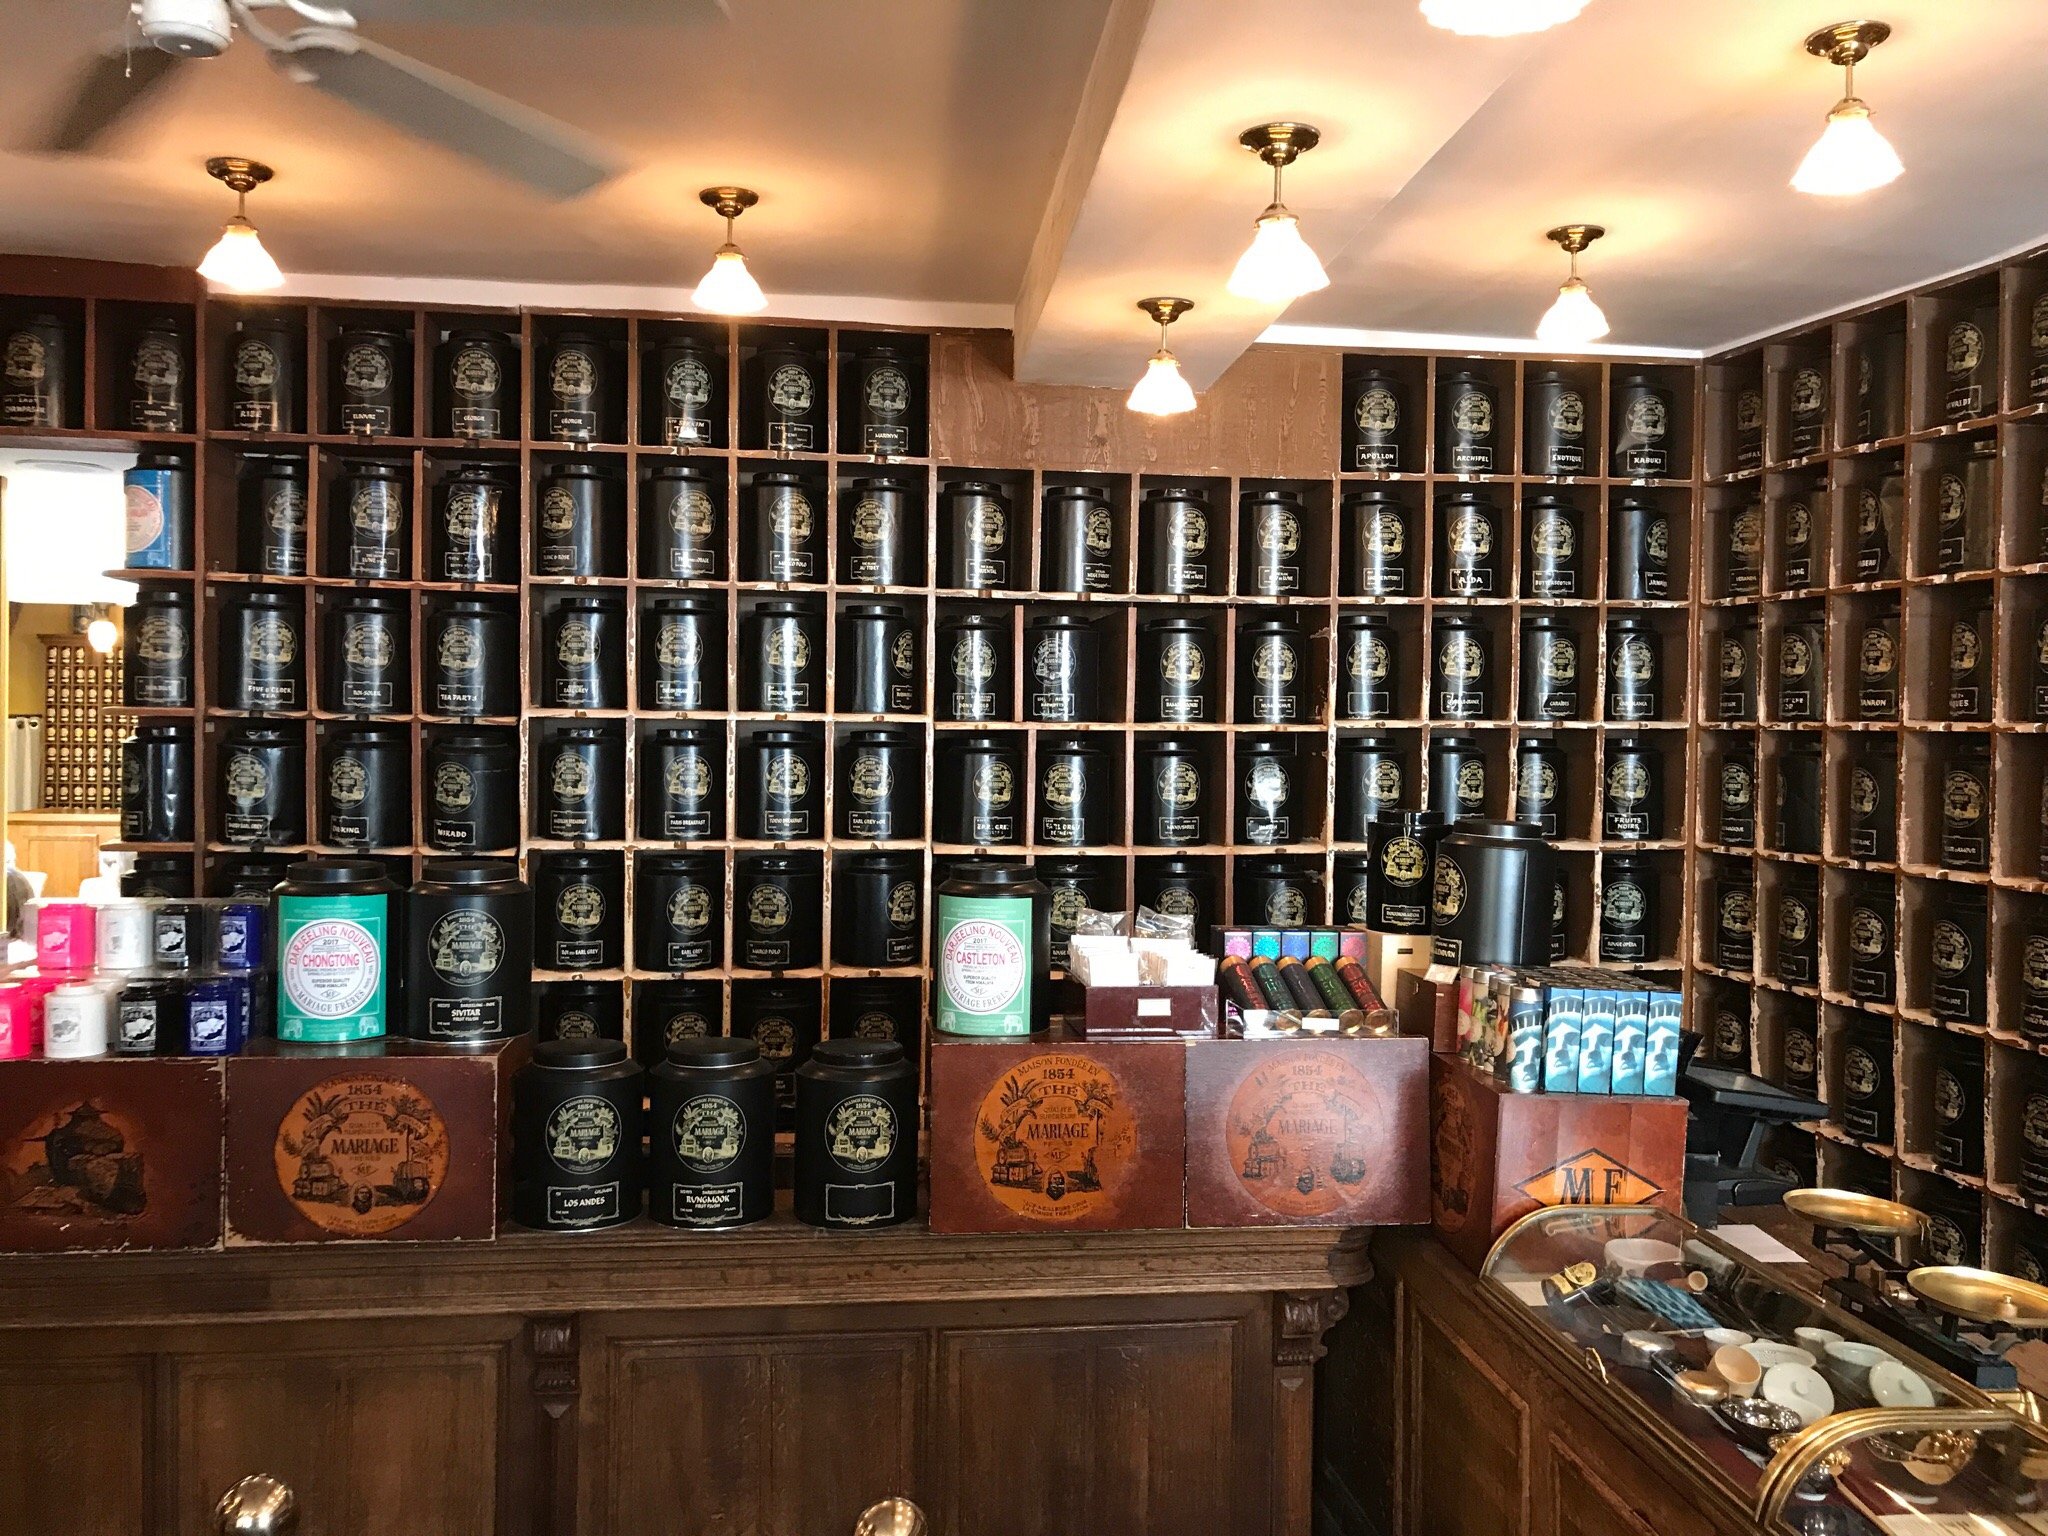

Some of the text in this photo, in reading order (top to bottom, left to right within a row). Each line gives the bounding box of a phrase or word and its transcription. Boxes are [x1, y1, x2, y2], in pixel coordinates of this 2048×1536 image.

[1360, 452, 1394, 460] APOLLON
[1456, 454, 1489, 463] ARCHIPEL
[1633, 456, 1662, 464] KABUKI
[1614, 816, 1642, 824] FRUITS
[288, 924, 376, 966] DARJEELING NOUVEAU
[322, 938, 339, 946] 2017
[451, 940, 485, 950] MARIAGE
[945, 925, 1019, 965] DARJEELING NOUVEAU
[302, 953, 360, 967] CHONGTONG
[956, 951, 1006, 965] CASTLETON
[296, 991, 333, 1014] MARIAGE
[951, 986, 981, 1009] MARIAGE
[451, 1008, 481, 1017] SIVITAR
[1017, 1058, 1053, 1077] MAISON
[1055, 1056, 1087, 1070] FONDÉE
[1292, 1065, 1323, 1076] 1854
[1043, 1068, 1076, 1080] 1854
[347, 1084, 383, 1096] 1854
[570, 1127, 601, 1138] MARIAGE
[694, 1127, 725, 1136] MARIAGE
[848, 1126, 879, 1136] MARIAGE
[1027, 1122, 1089, 1140] MARIAGE
[1278, 1119, 1338, 1135] MARIAGE
[331, 1137, 400, 1155] MARIAGE
[563, 1196, 606, 1207] LOS ANDES
[686, 1194, 730, 1204] RUNGMOOK
